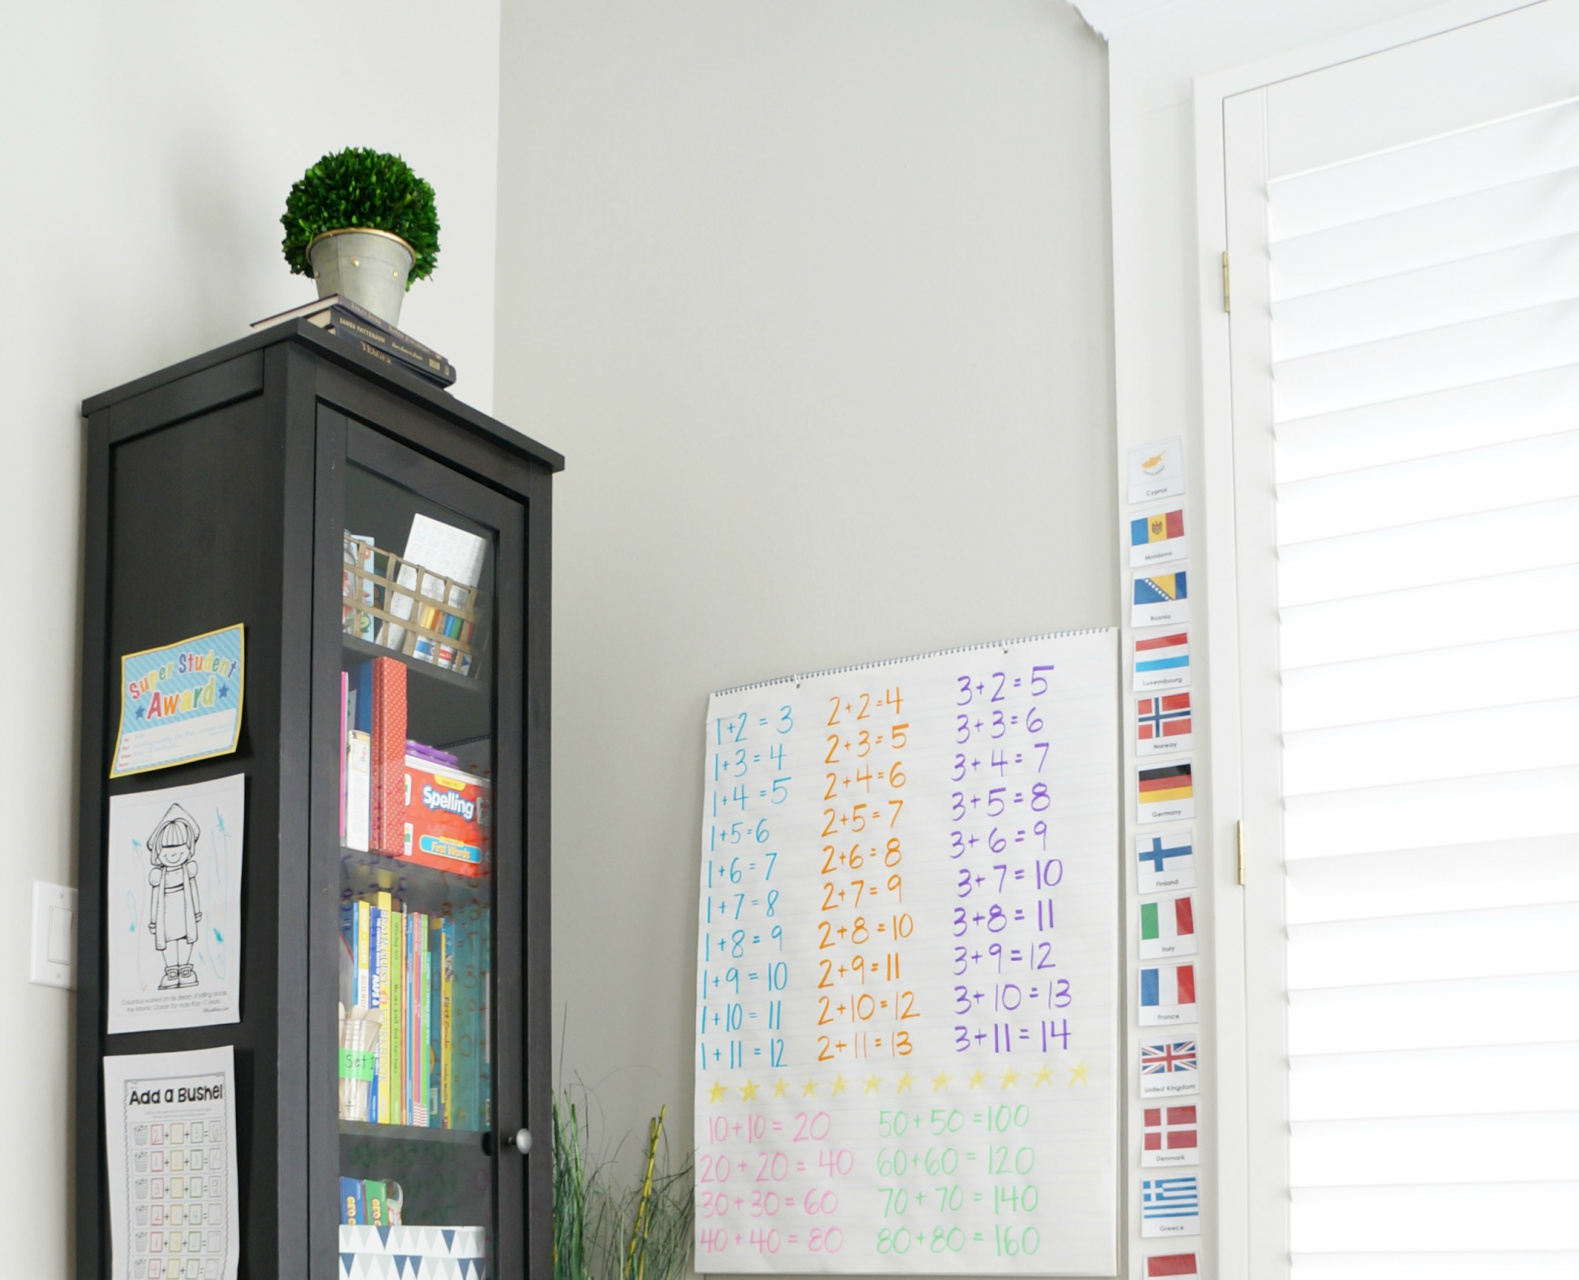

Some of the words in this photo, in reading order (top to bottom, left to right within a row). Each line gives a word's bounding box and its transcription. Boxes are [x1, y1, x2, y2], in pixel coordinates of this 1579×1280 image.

[128, 661, 174, 701] Super
[178, 649, 238, 679] Student
[146, 676, 216, 720] Award
[423, 785, 475, 821] Spelling
[380, 909, 389, 946] BRAIN
[380, 949, 389, 987] QUEST
[372, 975, 380, 998] MAPS
[129, 1089, 161, 1106] Add
[164, 1088, 174, 1104] a
[177, 1083, 224, 1104] Bushel
[1155, 1154, 1186, 1162] Denmark
